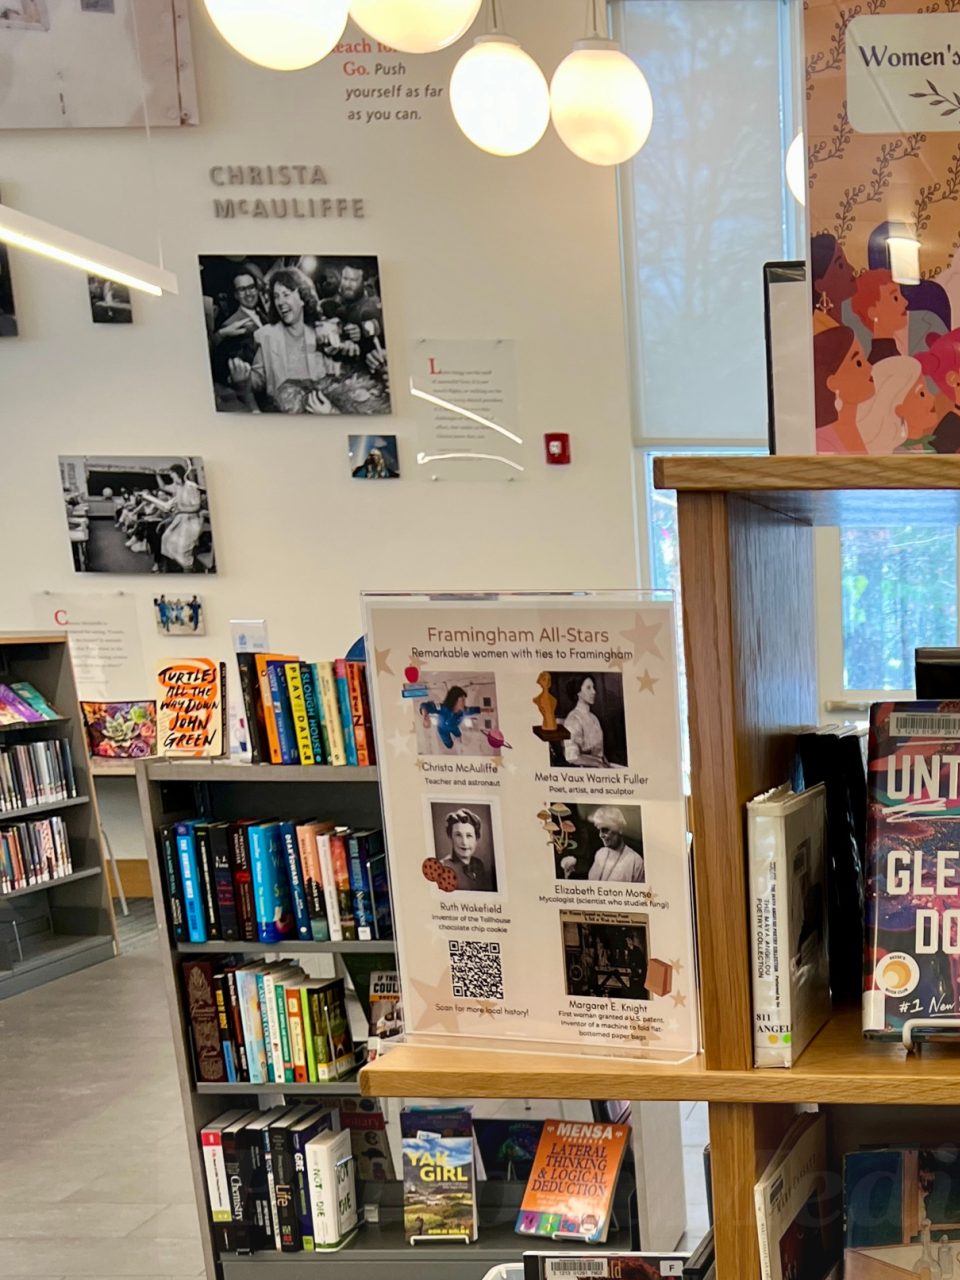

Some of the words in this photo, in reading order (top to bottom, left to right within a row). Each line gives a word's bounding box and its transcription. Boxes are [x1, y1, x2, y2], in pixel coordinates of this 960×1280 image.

[343, 60, 370, 76] Go.
[374, 61, 406, 75] Push
[345, 84, 402, 101] yourself
[405, 88, 420, 98] as
[424, 84, 443, 97] far
[347, 110, 361, 120] as
[366, 110, 390, 124] you
[395, 110, 422, 120] can.
[209, 165, 328, 186] CHRISTA
[427, 627, 534, 645] Framingham
[539, 627, 609, 643] All-Stars
[411, 647, 470, 659] Remarkable
[472, 649, 508, 659] women
[511, 648, 533, 659] with
[535, 648, 554, 659] ties
[556, 649, 567, 659] to
[569, 648, 633, 662] Framingham
[158, 666, 217, 684] TURTLES
[166, 686, 188, 698] ALL
[191, 687, 212, 697] THE
[160, 700, 184, 711] WAY
[185, 699, 219, 714] DOWN
[169, 711, 210, 731] JOHN
[164, 729, 217, 748] GREEN
[421, 762, 454, 773] Christa
[456, 762, 498, 774] McAuliffe
[424, 777, 451, 785] Teacher
[453, 778, 467, 786] and
[468, 779, 500, 787] astronaut
[535, 772, 559, 783] Meta
[560, 773, 584, 783] Vaux
[586, 773, 622, 785] Warrick
[623, 774, 648, 785] Fuller
[605, 787, 634, 796] sculptor
[555, 884, 596, 896] Elizabeth
[597, 886, 623, 897] Eaton
[625, 888, 652, 899] Morse
[440, 902, 459, 913] Ruth
[460, 903, 502, 914] Wakefield
[431, 914, 459, 922] Inventor
[460, 914, 467, 922] of
[468, 915, 478, 923] the
[479, 915, 511, 924] Tollhouse
[438, 924, 470, 932] chocolate
[471, 925, 485, 934] chip
[569, 1000, 609, 1012] Margaret
[611, 1002, 619, 1011] E.
[621, 1002, 648, 1015] Knight
[899, 1001, 923, 1013] #1
[929, 997, 955, 1014] New
[756, 1013, 771, 1022] 811
[557, 1122, 614, 1141] MENSA
[550, 1142, 608, 1158] LATERAL
[407, 1151, 449, 1167] YAK
[545, 1155, 608, 1172] THINKING
[419, 1165, 469, 1182] GIRL
[537, 1169, 547, 1181] &
[550, 1169, 607, 1185] LOGICAL
[531, 1179, 608, 1197] DEDUCTION
[230, 1175, 244, 1221] Chemistry
